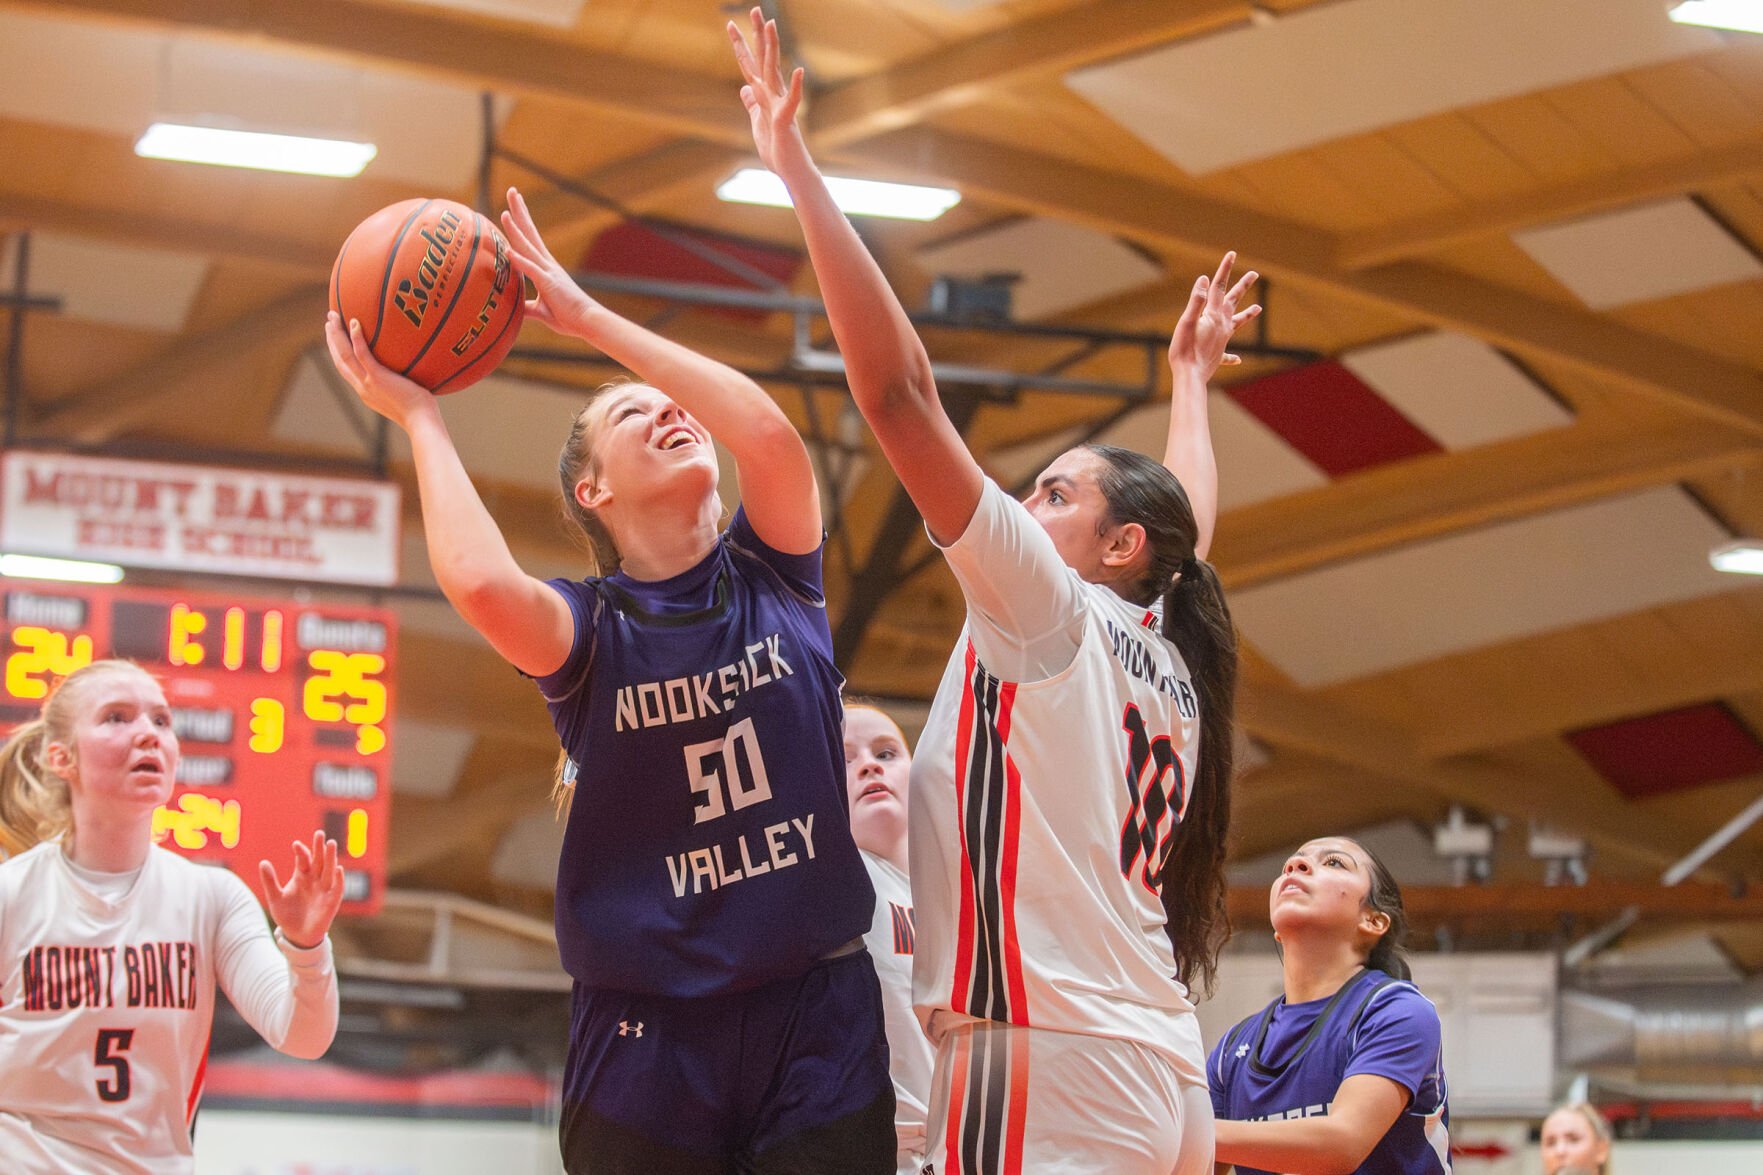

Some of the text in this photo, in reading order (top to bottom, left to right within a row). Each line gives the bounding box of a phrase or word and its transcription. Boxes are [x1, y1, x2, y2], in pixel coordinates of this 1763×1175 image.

[392, 209, 461, 329] Baden
[24, 468, 377, 530] MOUNT BAKER
[303, 650, 386, 724] 25
[615, 633, 794, 732] NOOKSICK
[249, 697, 284, 753] 3
[683, 717, 773, 825] 50
[1121, 702, 1186, 897] 10
[665, 814, 816, 898] VALLEY
[23, 946, 116, 1011] MOUNT
[94, 1028, 136, 1103] 5
